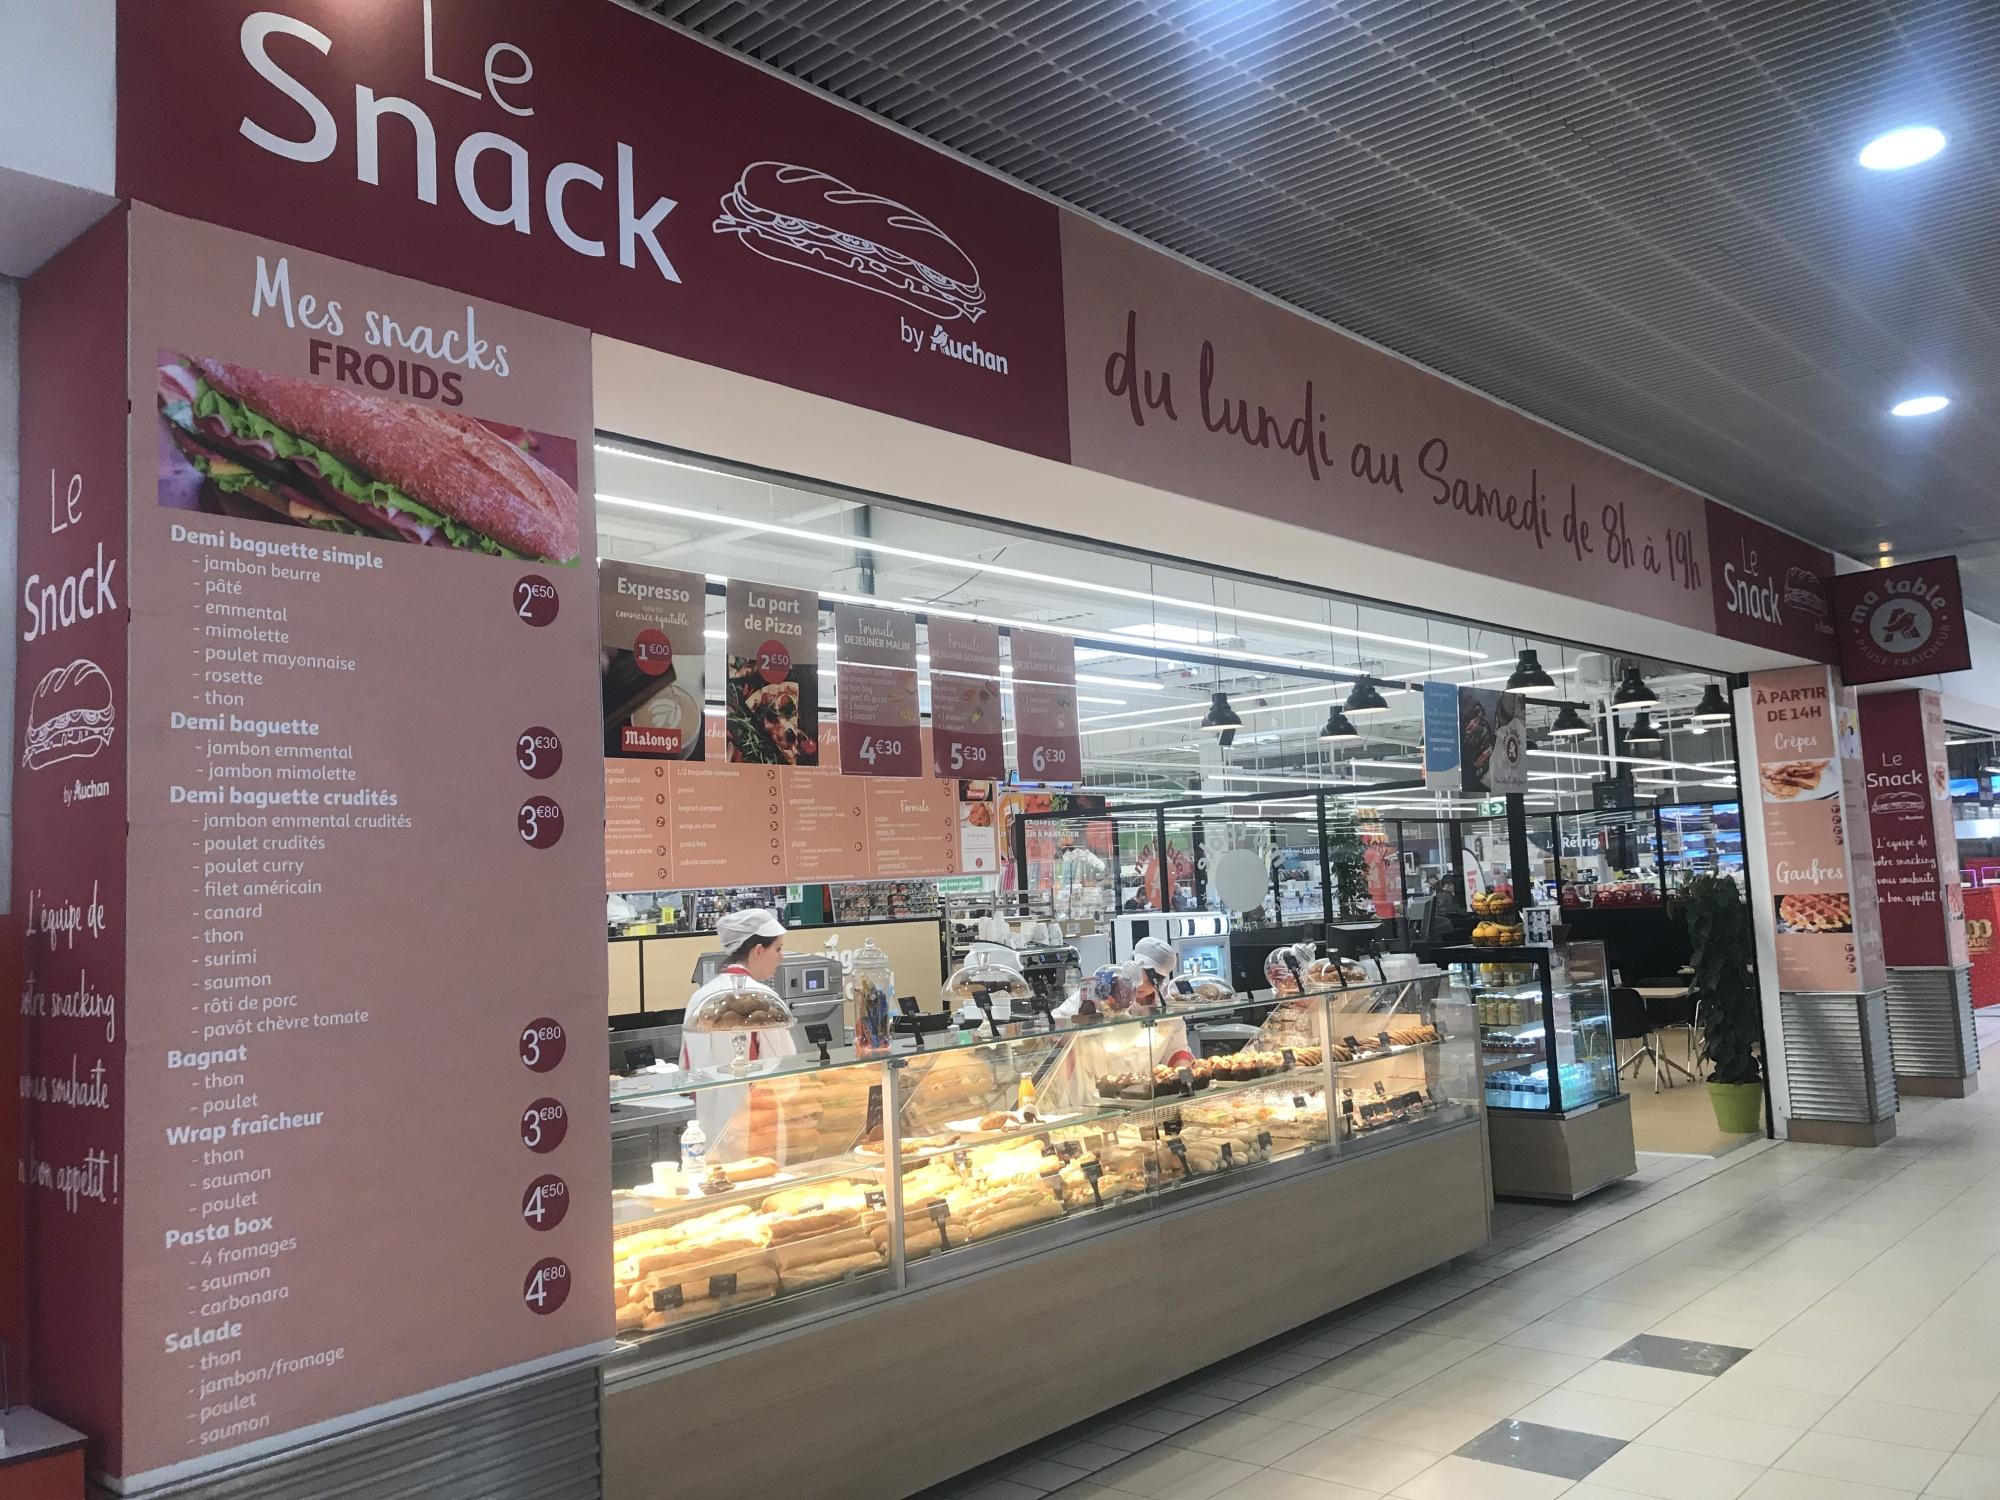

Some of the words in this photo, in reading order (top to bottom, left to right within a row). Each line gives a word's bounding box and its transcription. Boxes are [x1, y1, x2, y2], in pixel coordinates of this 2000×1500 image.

[423, 0, 534, 117] Le
[238, 10, 683, 285] Snack
[251, 255, 344, 337] Mes
[364, 306, 510, 378] snacks
[900, 316, 925, 352] by
[929, 323, 1009, 375] Auchan
[308, 338, 464, 408] FROIDS
[1104, 309, 1178, 427] du
[1199, 340, 1335, 481] lundi
[1350, 448, 1404, 495] au
[1417, 436, 1552, 549] Samedi
[1562, 483, 1594, 562] de
[1602, 501, 1634, 573] 8h
[1642, 536, 1661, 575] à
[1667, 524, 1701, 589] 19h
[51, 468, 82, 534] Le
[171, 524, 225, 548] Demi
[230, 533, 318, 558] baguette
[322, 545, 383, 570] simple
[1741, 536, 1758, 577] Le
[204, 555, 267, 576] jambon
[271, 562, 321, 583] beurre
[24, 541, 117, 641] Snack
[205, 578, 243, 597] pâté
[517, 582, 555, 618] 2€50
[617, 577, 690, 603] Expresso
[1724, 562, 1783, 626] Snack
[1851, 591, 1879, 624] ma
[1884, 577, 1947, 611] table
[205, 602, 288, 622] emmental
[748, 592, 765, 609] La
[769, 597, 800, 614] part
[615, 610, 654, 623] commerce
[655, 613, 689, 629] équitable
[744, 616, 762, 631] de
[765, 617, 802, 636] Pizza
[858, 617, 895, 638] Formule
[205, 624, 290, 643] mimolette
[845, 634, 884, 648] DEJEUNER
[886, 639, 910, 651] MALIN
[205, 646, 258, 667] poulet
[262, 654, 356, 672] mayonnaise
[1857, 638, 1888, 666] PAUSE
[205, 670, 263, 686] rosette
[205, 691, 244, 706] thon
[1756, 690, 1768, 706] À
[1770, 686, 1826, 704] PARTIR
[171, 712, 225, 732] Demi
[230, 715, 320, 738] baguette
[1767, 708, 1788, 722] DE
[1790, 705, 1822, 720] 14H
[206, 742, 270, 759] jambon
[275, 744, 353, 760] emmental
[518, 735, 558, 772] 3€30
[625, 730, 679, 751] Malongo
[859, 736, 902, 765] 4€30
[1775, 732, 1818, 752] Crêpes
[950, 742, 987, 770] 5€30
[1032, 746, 1066, 772] 6€30
[1882, 752, 1903, 767] Le
[208, 764, 272, 781] jambon
[276, 766, 356, 781] mimolette
[1867, 769, 1923, 788] Snack
[63, 785, 72, 807] by
[74, 779, 109, 799] Auchan
[170, 785, 225, 804] Demi
[230, 787, 319, 811] baguette
[324, 787, 398, 807] crudités
[900, 800, 930, 813] Formule
[203, 813, 267, 830] jambon
[272, 814, 351, 828] emmental
[355, 813, 412, 829] crudités
[520, 805, 559, 841] 3€80
[204, 836, 259, 855] poulet
[262, 836, 325, 850] crudités
[1917, 834, 1928, 847] de
[204, 859, 259, 877] poulet
[262, 860, 304, 876] curry
[1776, 857, 1843, 886] Gaufres
[1896, 852, 1937, 869] snacking
[204, 881, 239, 897] filet
[243, 880, 321, 895] américain
[1877, 875, 1897, 885] vous
[1899, 871, 1936, 885] souhaite
[26, 888, 82, 951] L'équipe
[87, 879, 105, 938] de
[204, 904, 262, 920] canard
[204, 928, 243, 943] thon
[204, 950, 257, 966] surimi
[204, 972, 271, 990] saumon
[51, 968, 115, 1042] snacking
[204, 997, 233, 1014] rôti
[238, 995, 258, 1012] de
[262, 994, 298, 1015] porc
[204, 1019, 253, 1041] pavôt
[257, 1014, 309, 1033] chèvre
[313, 1008, 369, 1028] tomate
[167, 1044, 247, 1070] Bagnat
[522, 1026, 561, 1066] 3€80
[51, 1054, 109, 1109] souhaite
[204, 1071, 244, 1088] thon
[203, 1093, 258, 1114] poulet
[166, 1122, 227, 1146] Wrap
[231, 1109, 324, 1136] fraîcheur
[523, 1105, 563, 1148] 3€80
[204, 1147, 244, 1164] thon
[57, 1148, 109, 1214] appétit
[202, 1166, 271, 1190] saumon
[201, 1191, 258, 1218] poulet
[524, 1182, 564, 1224] 4€50
[165, 1221, 229, 1249] Pasta
[234, 1214, 273, 1234] box
[201, 1249, 214, 1267] 4
[217, 1237, 297, 1265] fromages
[201, 1264, 271, 1292] saumon
[525, 1264, 566, 1308] 4€80
[200, 1285, 290, 1317] carbonara
[164, 1321, 242, 1353] Salade
[200, 1348, 242, 1370] thon
[199, 1345, 345, 1400] jambon/fromage
[199, 1393, 257, 1424] poulet
[199, 1414, 270, 1446] saumon
